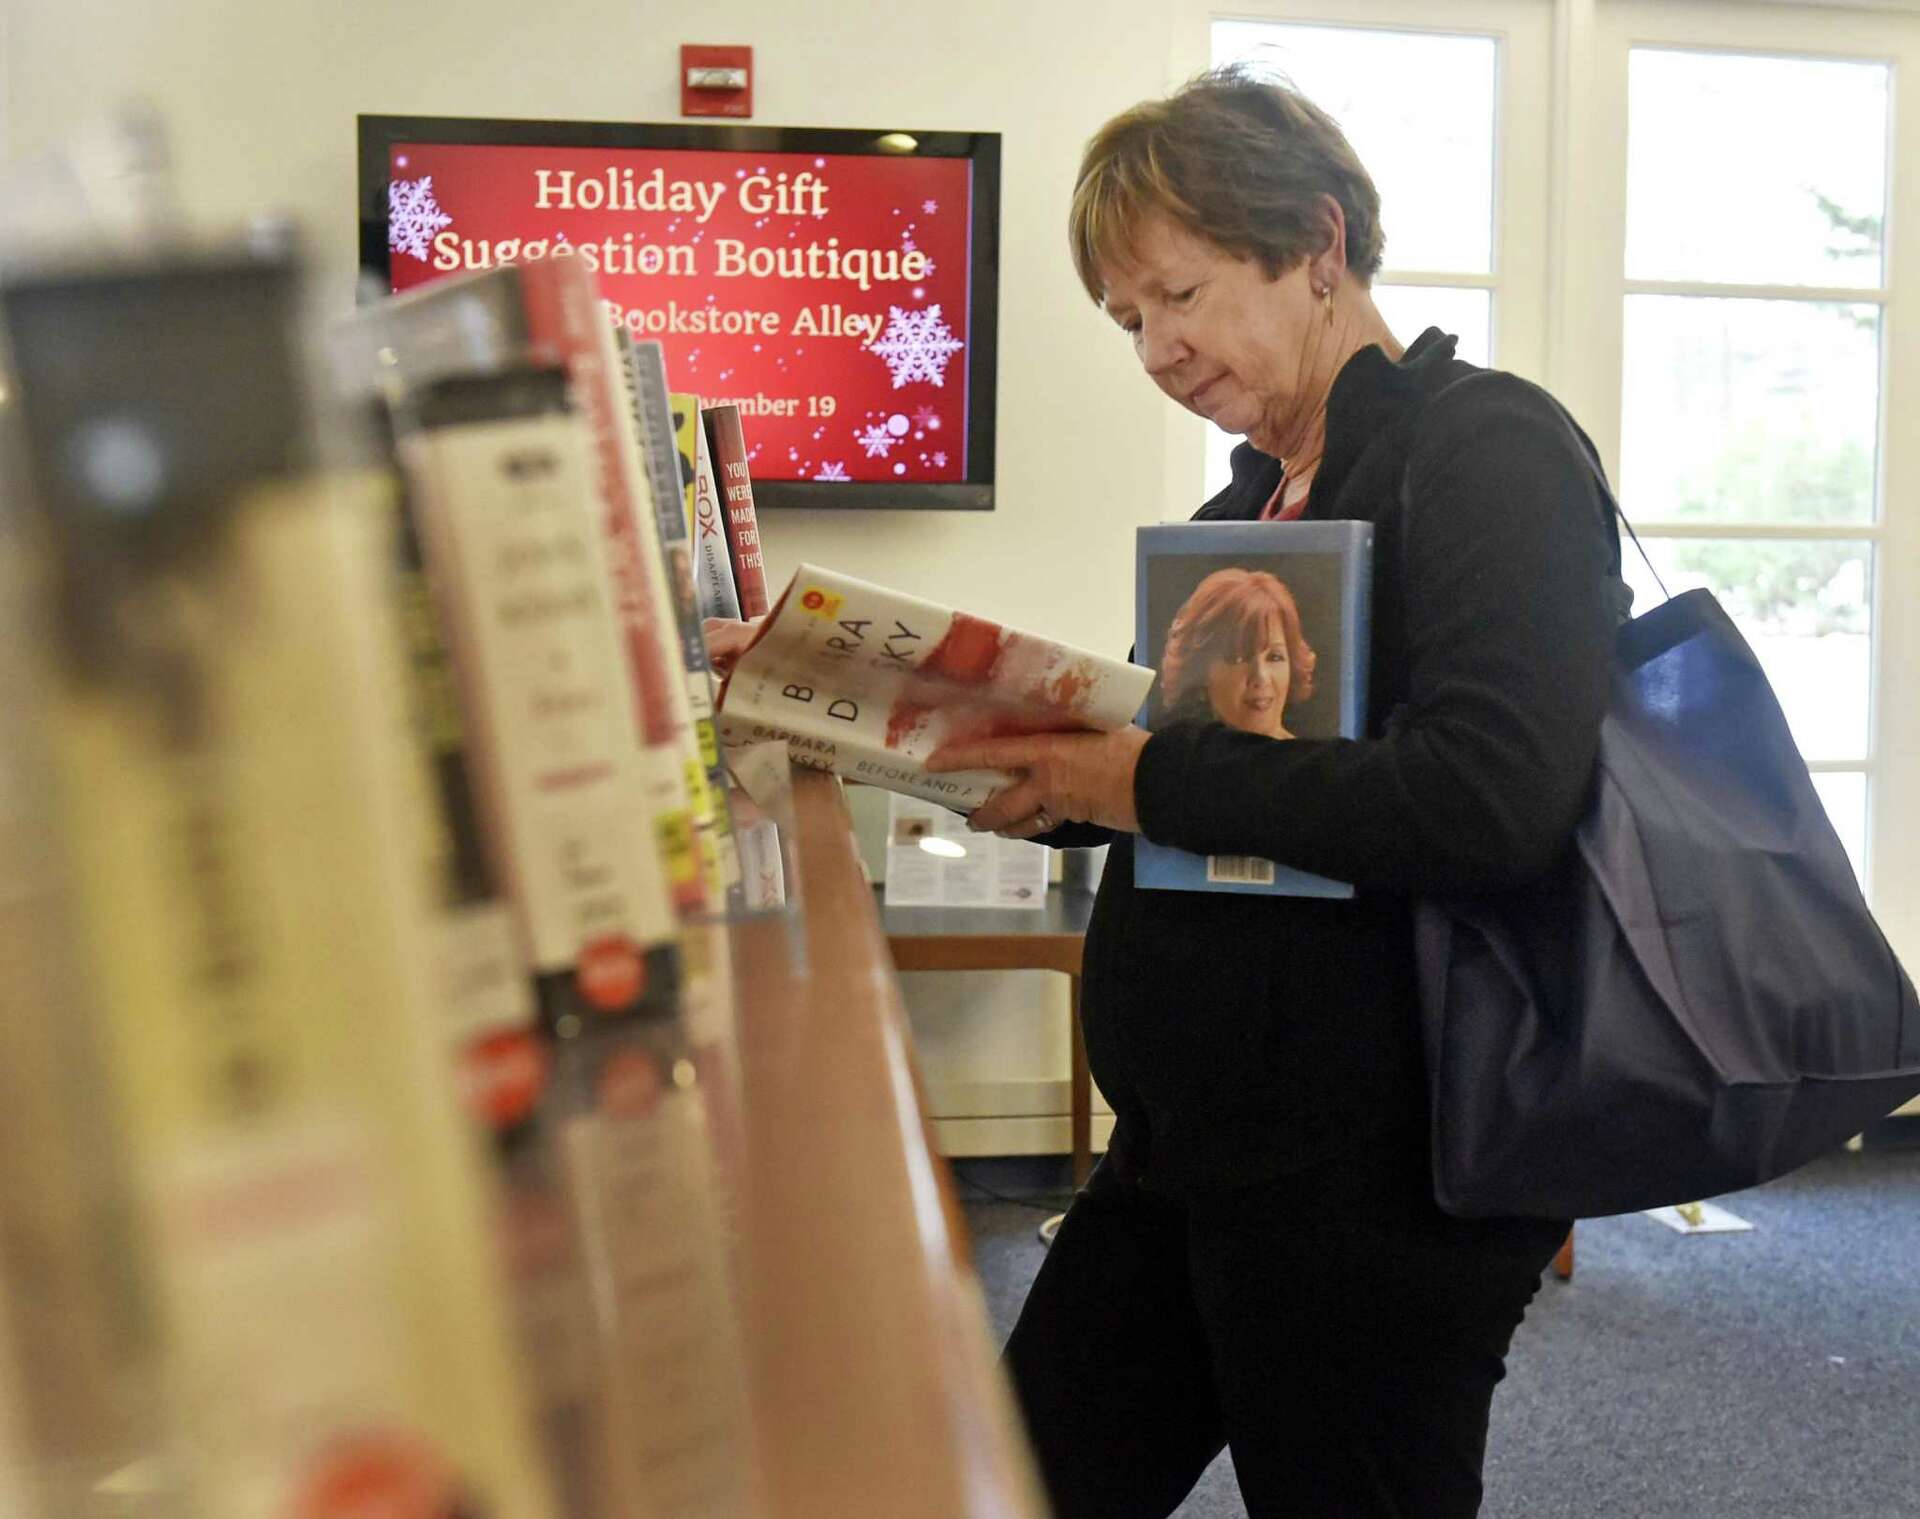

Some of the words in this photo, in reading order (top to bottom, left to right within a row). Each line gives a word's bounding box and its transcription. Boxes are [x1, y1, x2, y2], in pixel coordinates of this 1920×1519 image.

[533, 167, 725, 223] Holiday
[739, 172, 829, 216] Gift
[714, 237, 926, 291] Boutique
[605, 301, 780, 336] Bookstore
[791, 304, 884, 346] Alley
[808, 395, 837, 417] 19
[726, 462, 747, 479] YOU
[739, 551, 764, 570] THIS
[856, 759, 920, 785] BEFORE
[920, 777, 959, 794] AND
